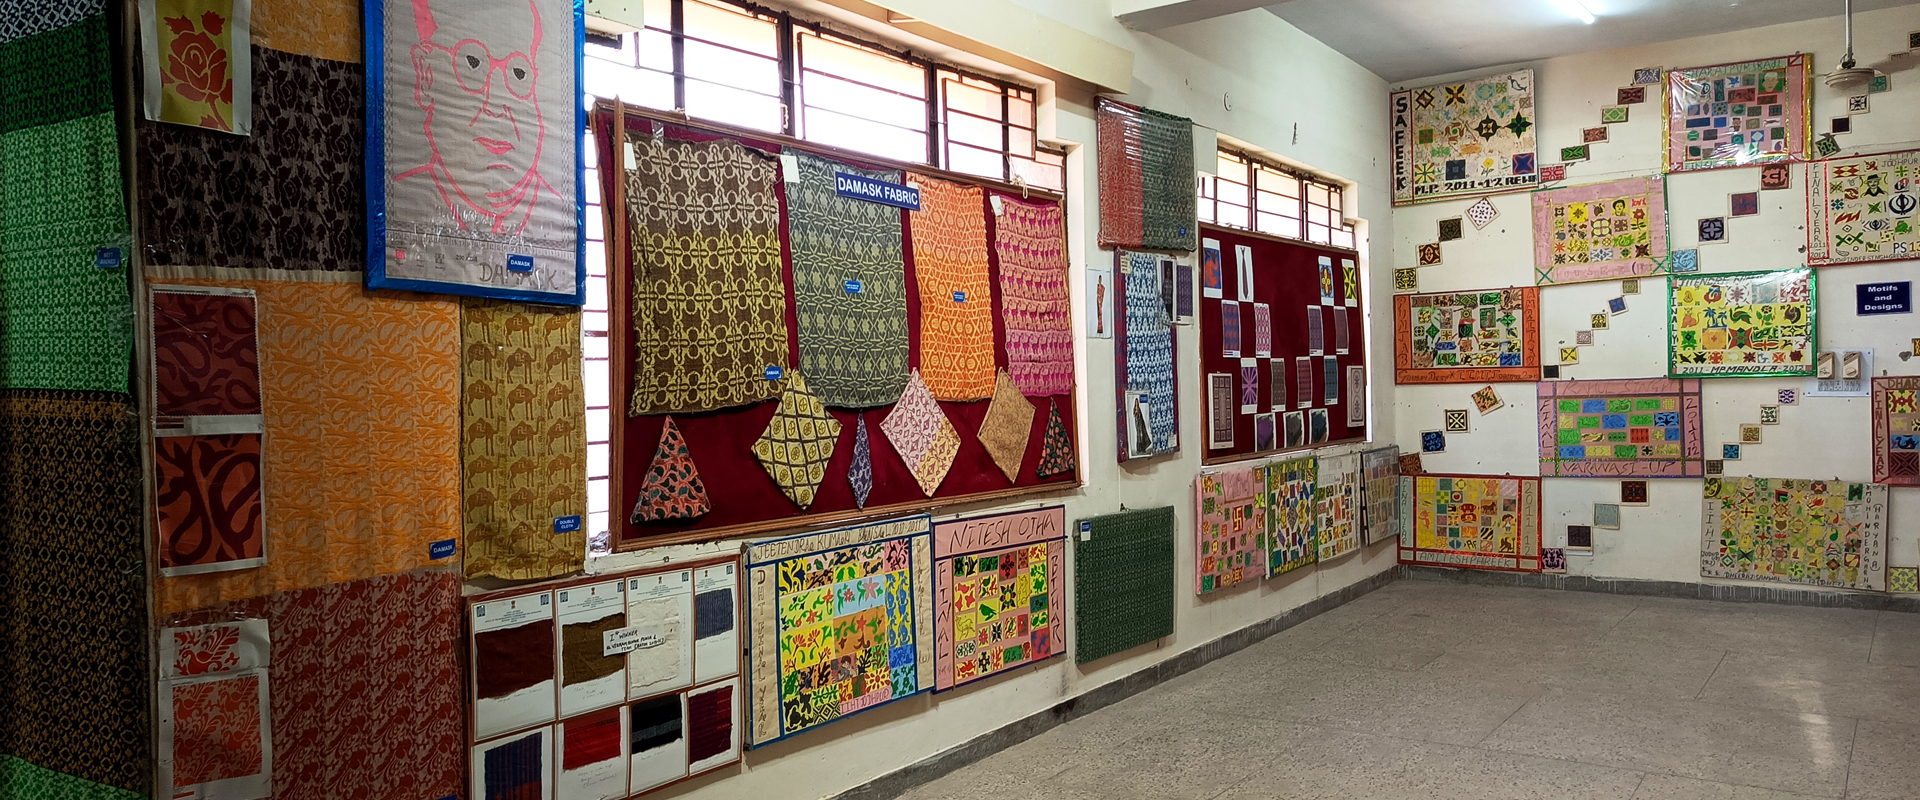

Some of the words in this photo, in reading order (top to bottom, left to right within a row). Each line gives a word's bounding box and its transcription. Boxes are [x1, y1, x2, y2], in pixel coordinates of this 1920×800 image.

[837, 177, 883, 198] DAMASK
[884, 187, 918, 205] FABRIC
[510, 259, 531, 267] DAMASK
[950, 518, 1013, 553] NITESH
[1018, 513, 1056, 540] OJHA
[433, 544, 453, 553] DAMASK
[937, 562, 952, 660] FINAL
